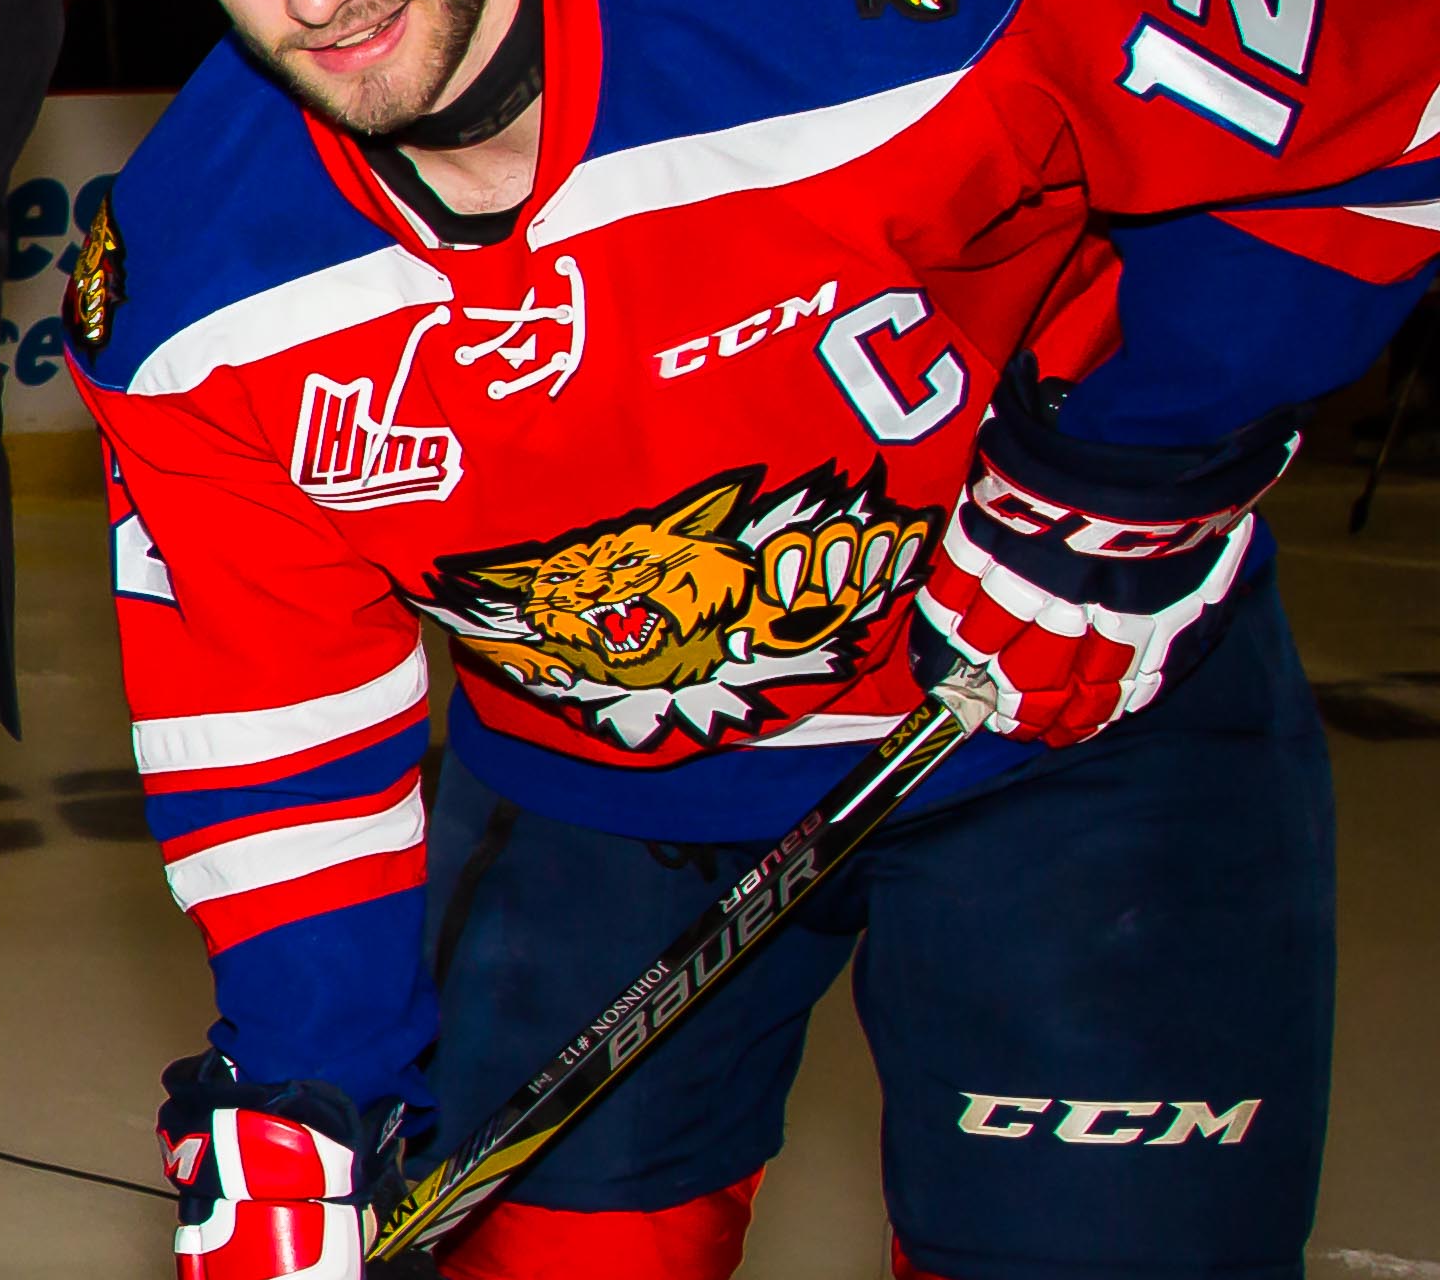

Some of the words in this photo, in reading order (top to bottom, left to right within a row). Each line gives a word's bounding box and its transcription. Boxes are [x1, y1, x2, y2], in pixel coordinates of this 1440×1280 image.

[653, 281, 838, 382] CCM
[817, 288, 969, 445] C
[590, 960, 671, 1038] JOHNSON
[957, 1091, 1262, 1145] CCM
